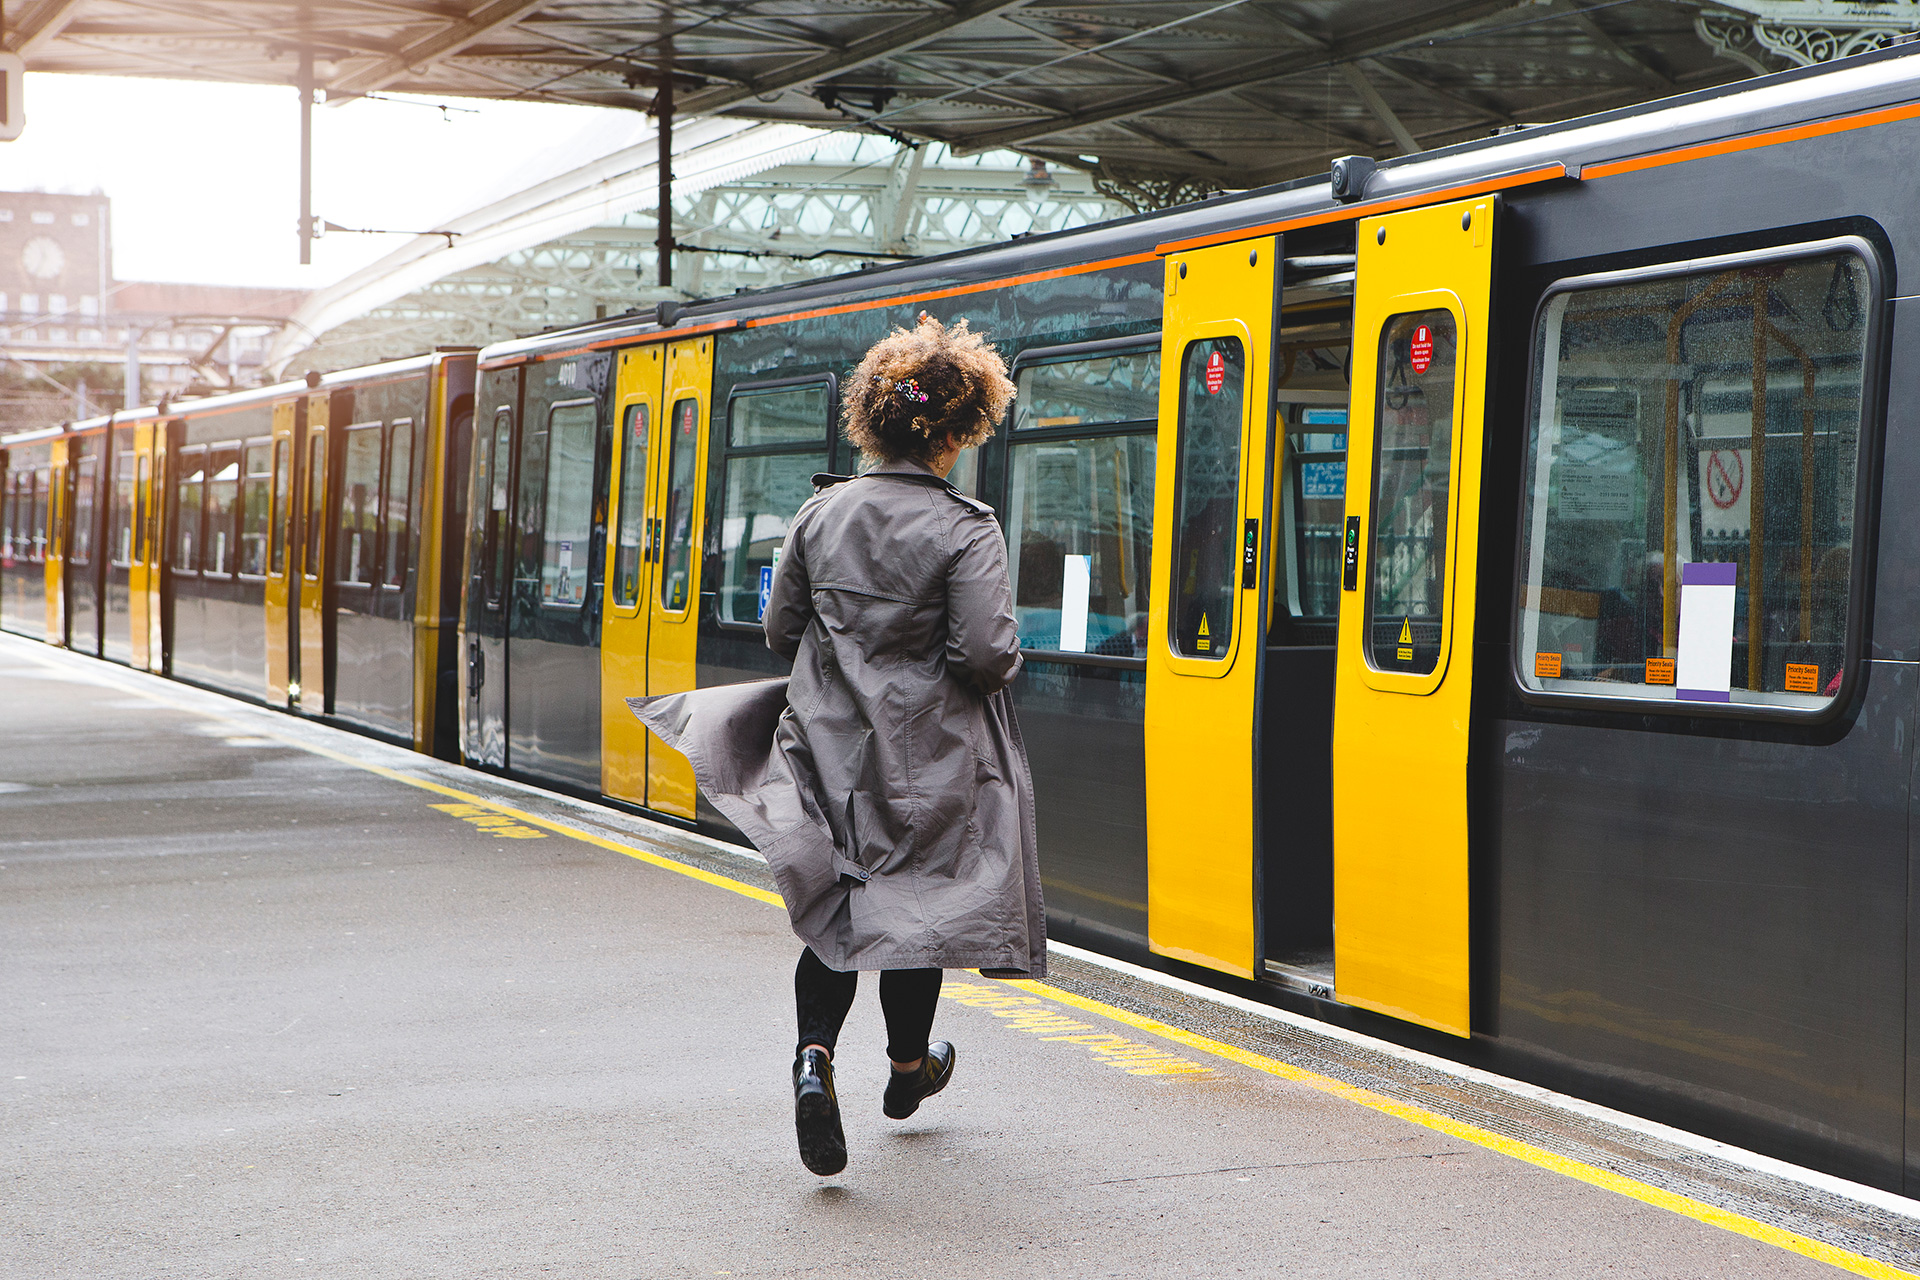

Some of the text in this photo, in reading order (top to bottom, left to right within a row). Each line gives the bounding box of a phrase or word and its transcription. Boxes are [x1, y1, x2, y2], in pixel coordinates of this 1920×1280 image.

[1648, 660, 1661, 668] Priority
[1788, 666, 1803, 674] Priority
[991, 1009, 1095, 1033] the
[1038, 1033, 1215, 1076] Mind
